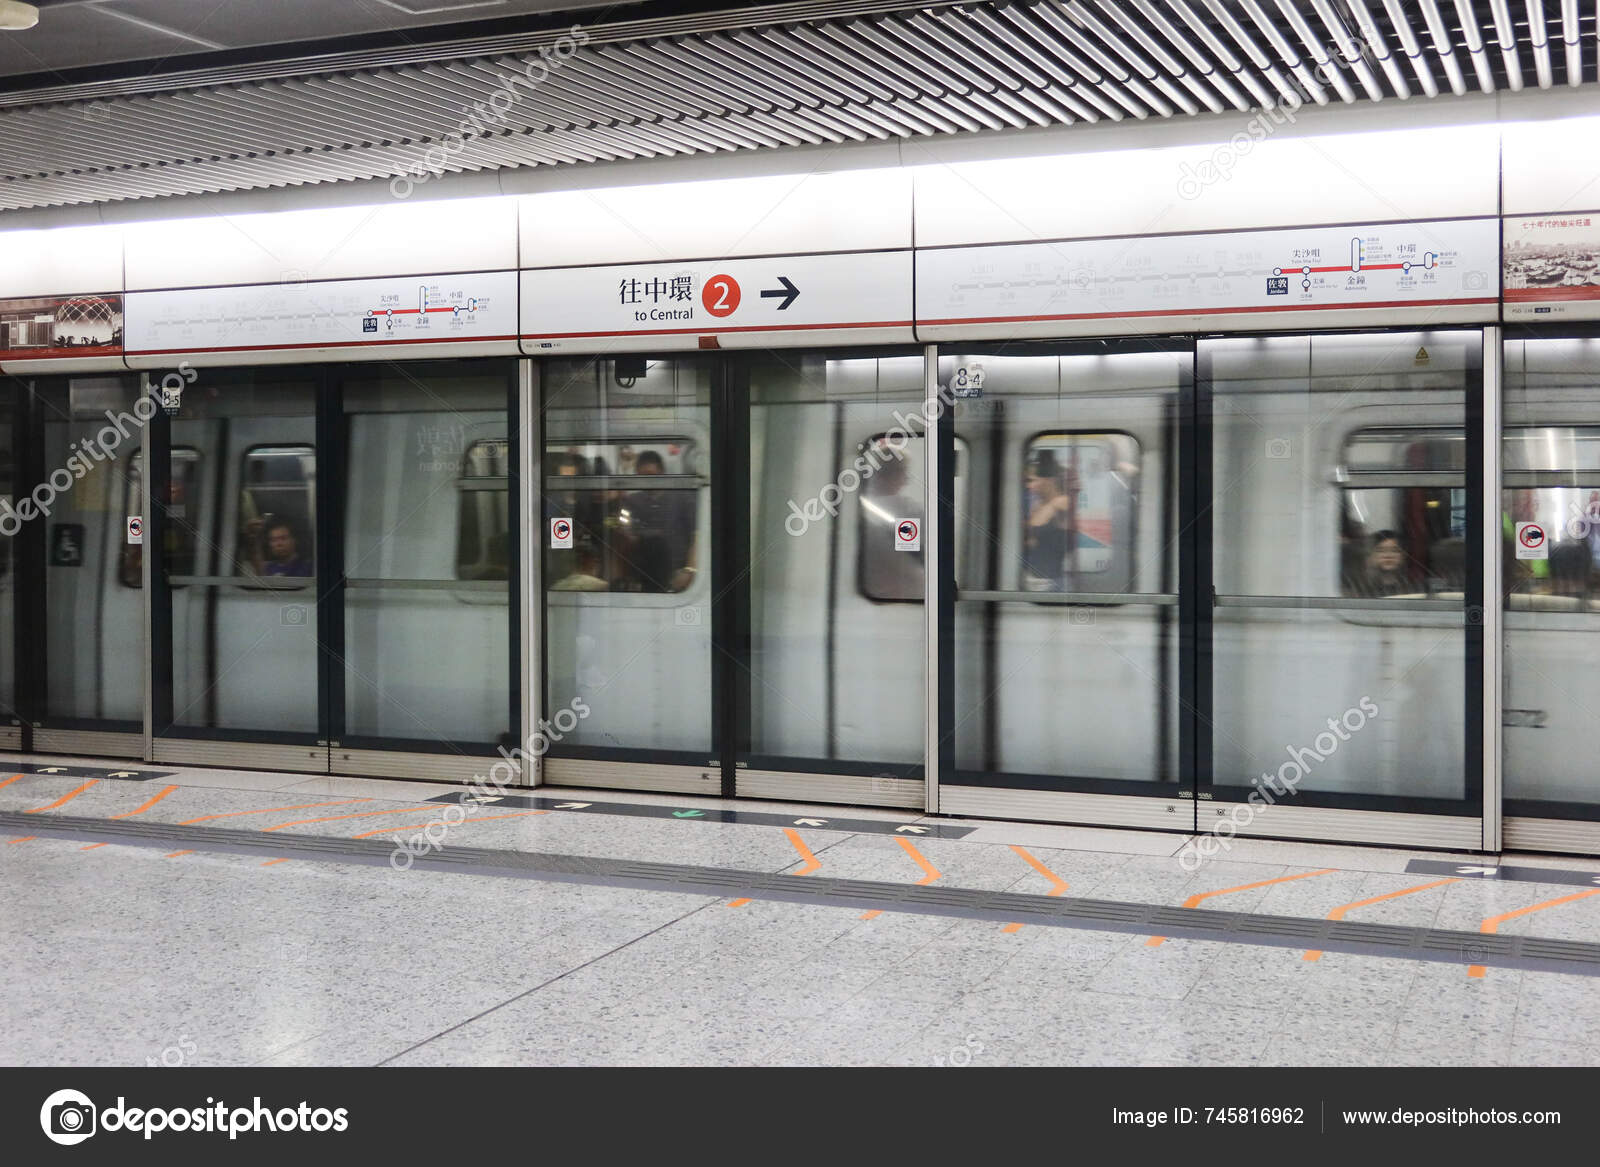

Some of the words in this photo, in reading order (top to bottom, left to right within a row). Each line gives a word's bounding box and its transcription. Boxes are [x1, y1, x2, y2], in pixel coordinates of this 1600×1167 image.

[619, 276, 692, 304] 往中環
[714, 282, 730, 309] 2
[635, 311, 647, 321] to
[650, 306, 693, 320] Central
